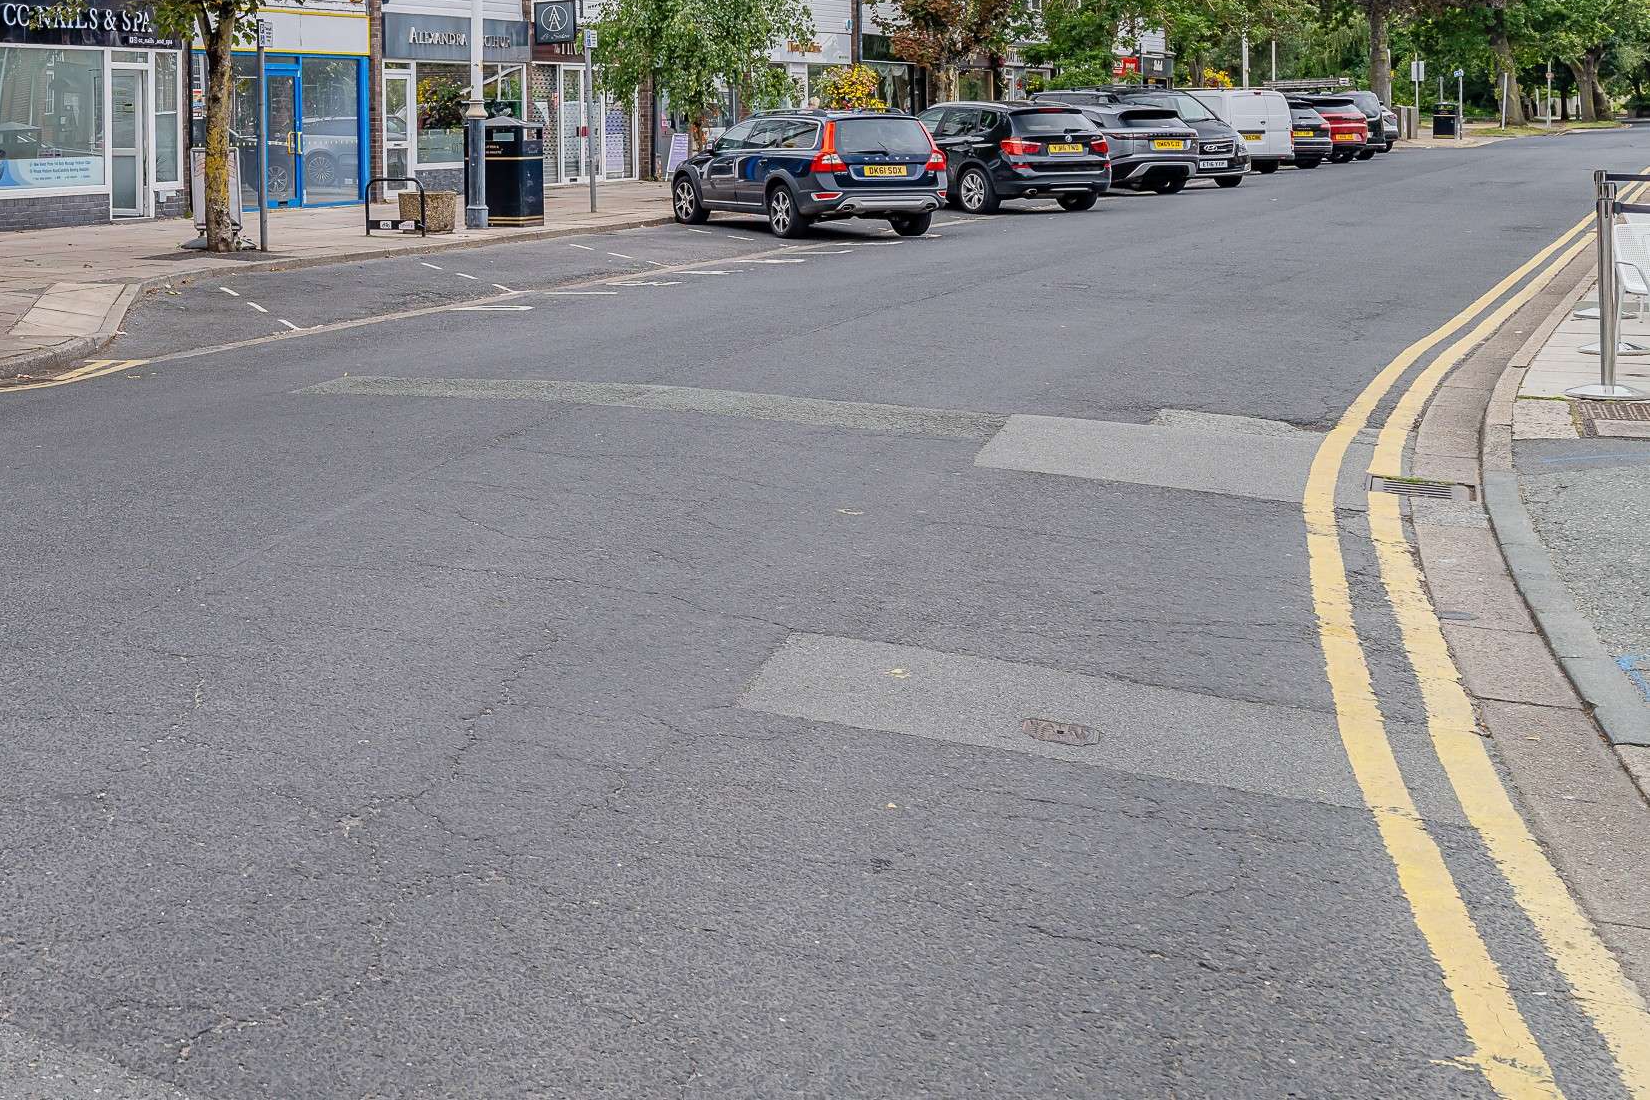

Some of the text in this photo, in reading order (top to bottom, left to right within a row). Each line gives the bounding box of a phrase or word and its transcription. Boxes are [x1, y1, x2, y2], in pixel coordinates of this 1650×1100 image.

[3, 3, 153, 33] CC NAILS & SPA
[409, 26, 468, 46] ALEXANDRA
